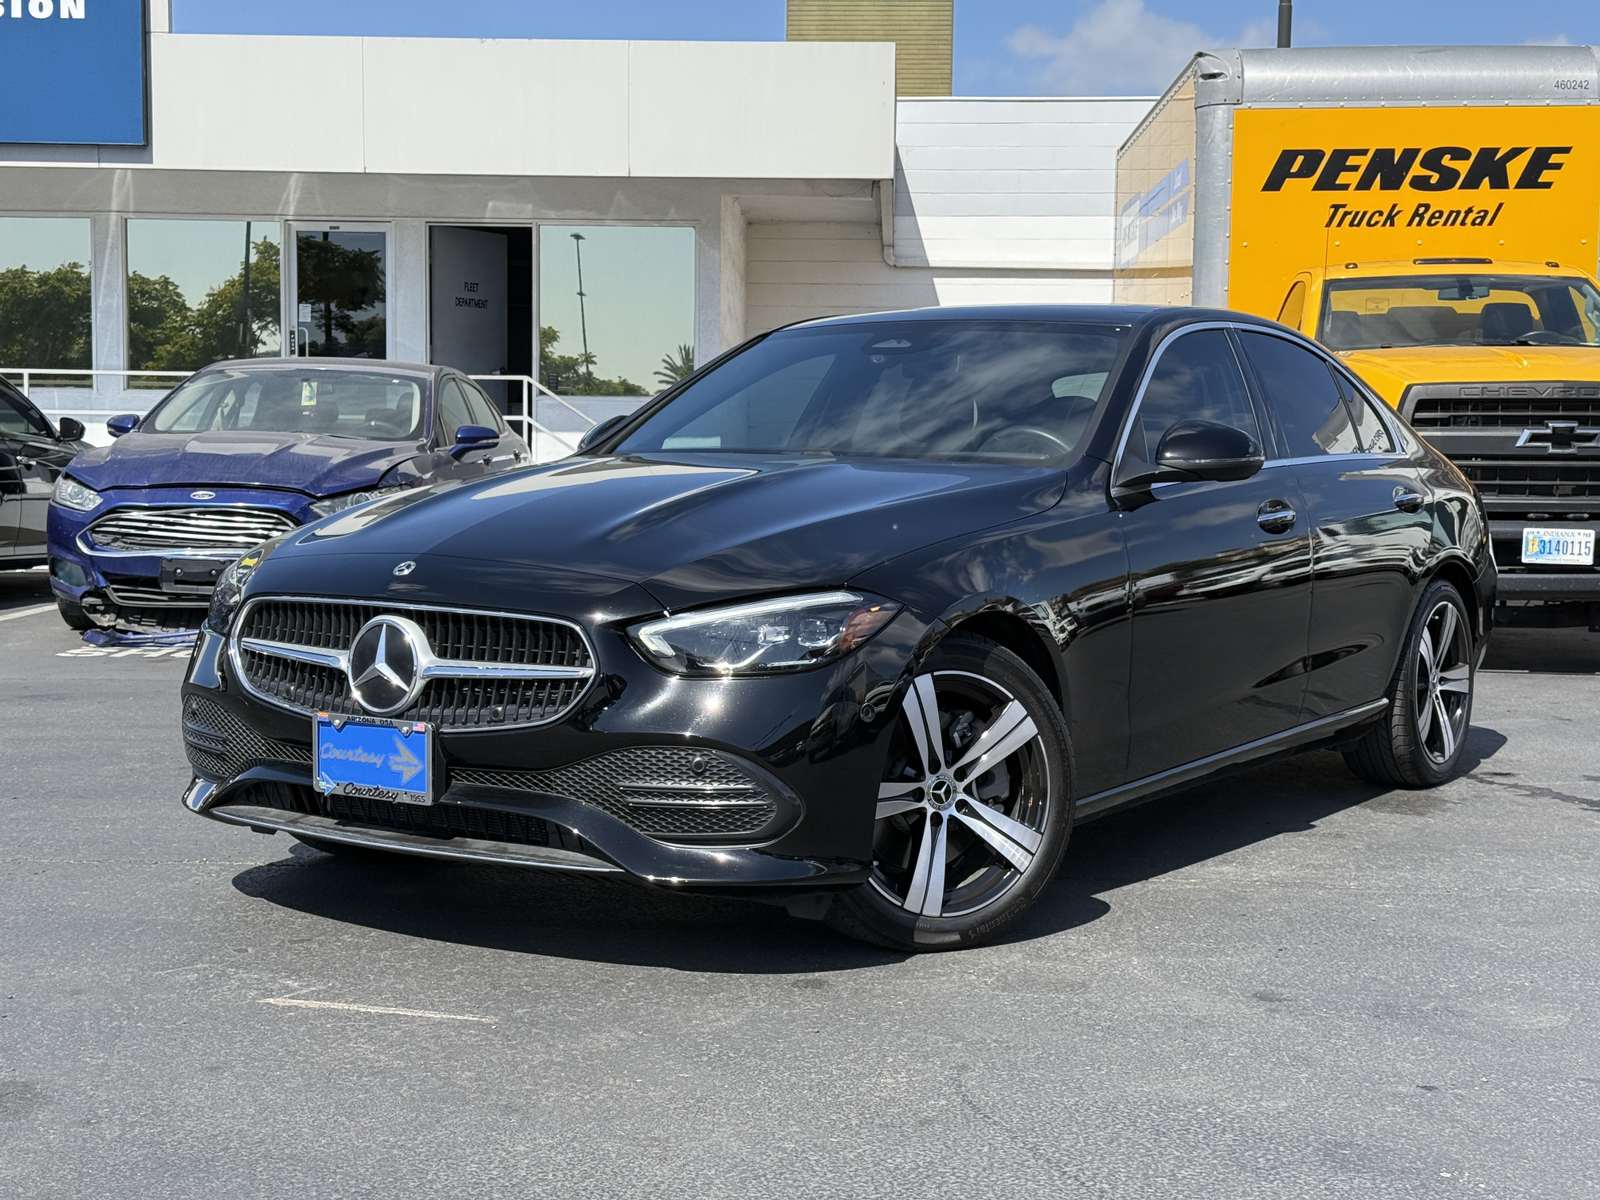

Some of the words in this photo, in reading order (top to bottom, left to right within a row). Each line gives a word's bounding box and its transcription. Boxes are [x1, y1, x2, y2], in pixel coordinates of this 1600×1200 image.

[0, 0, 86, 19] ION
[1554, 79, 1590, 90] 460242
[1260, 146, 1573, 192] PENSKE
[1324, 202, 1403, 228] Truck
[1405, 202, 1505, 227] Rental
[464, 281, 479, 293] FLEET
[455, 296, 489, 310] DEPARTMENT
[1543, 530, 1575, 538] INDIANA
[1539, 539, 1592, 556] 3140115
[346, 715, 376, 725] ARIZONA
[379, 718, 394, 726] USA
[320, 743, 385, 769] Courtesy
[343, 782, 399, 803] Courtesy
[409, 794, 426, 803] 1955
